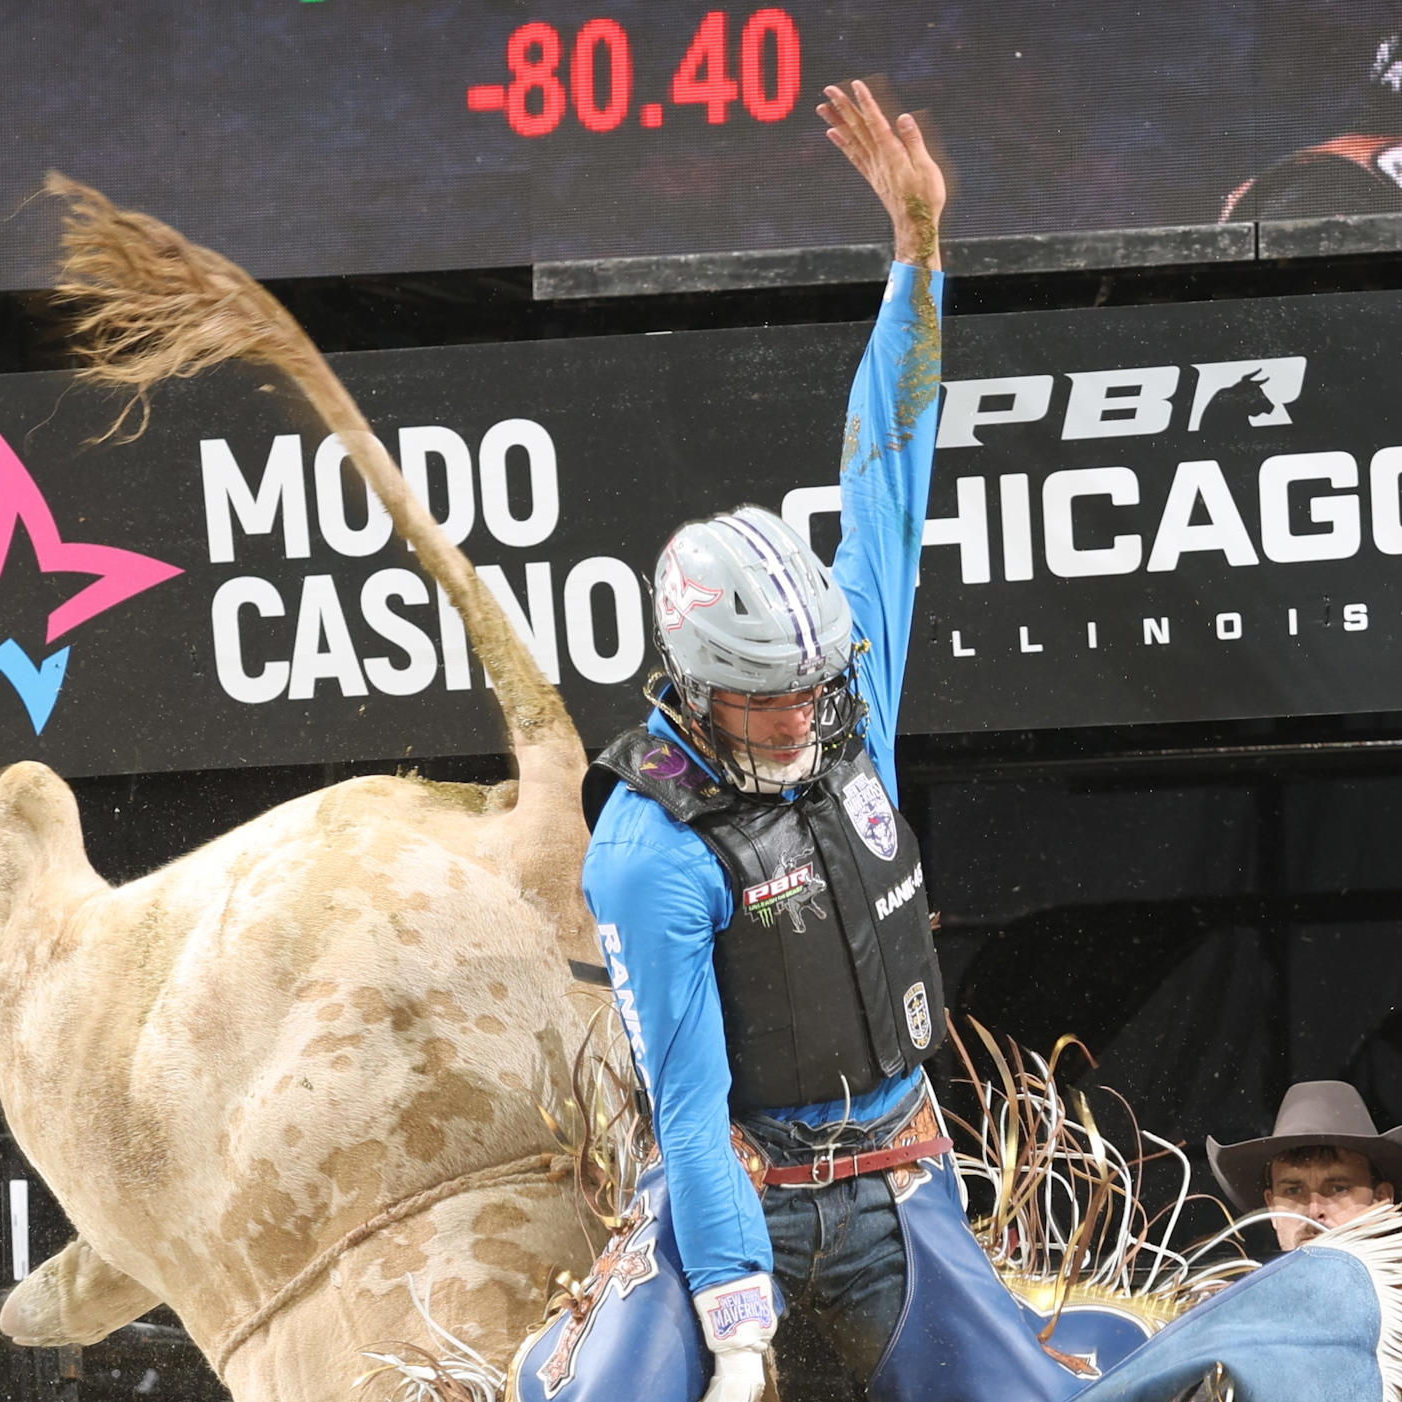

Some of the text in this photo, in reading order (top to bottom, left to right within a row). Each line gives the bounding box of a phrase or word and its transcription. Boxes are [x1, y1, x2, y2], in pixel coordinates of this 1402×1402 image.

[467, 8, 801, 138] -80.40
[200, 419, 559, 563] MODO
[210, 556, 645, 704] CASINO
